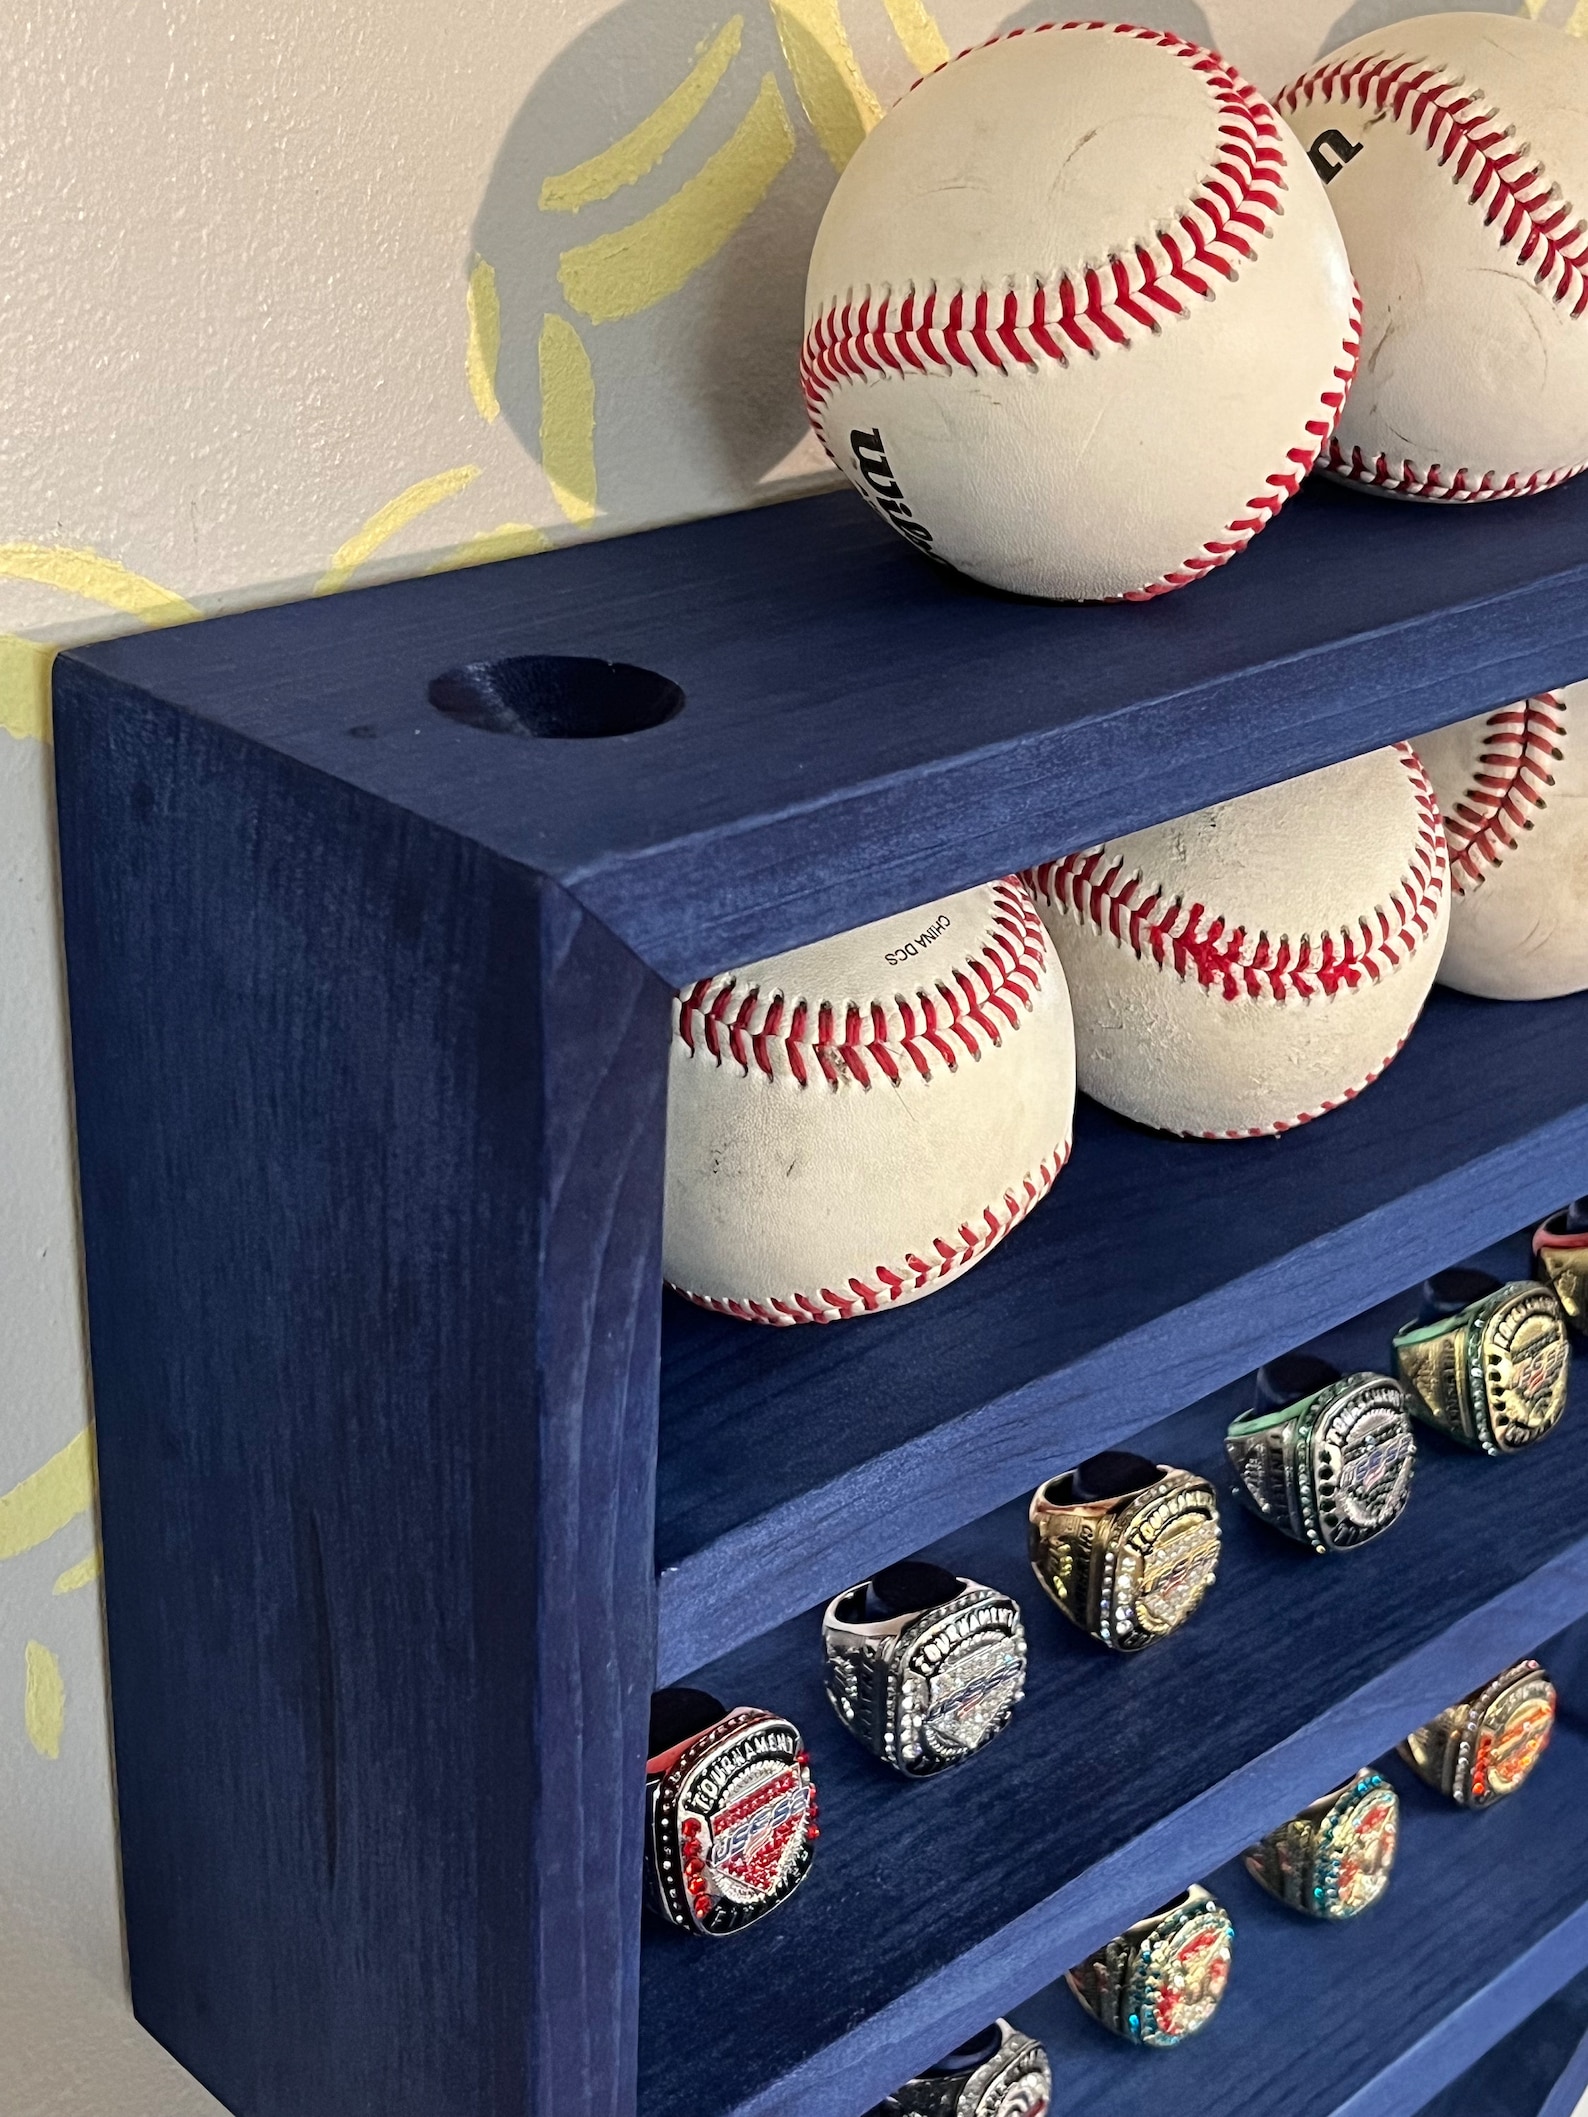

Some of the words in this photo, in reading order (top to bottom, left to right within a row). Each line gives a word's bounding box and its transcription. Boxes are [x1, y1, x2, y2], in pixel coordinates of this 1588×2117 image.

[914, 914, 951, 948] CHINA
[884, 942, 919, 966] DCS
[692, 1731, 795, 1813] TOURNAMENT
